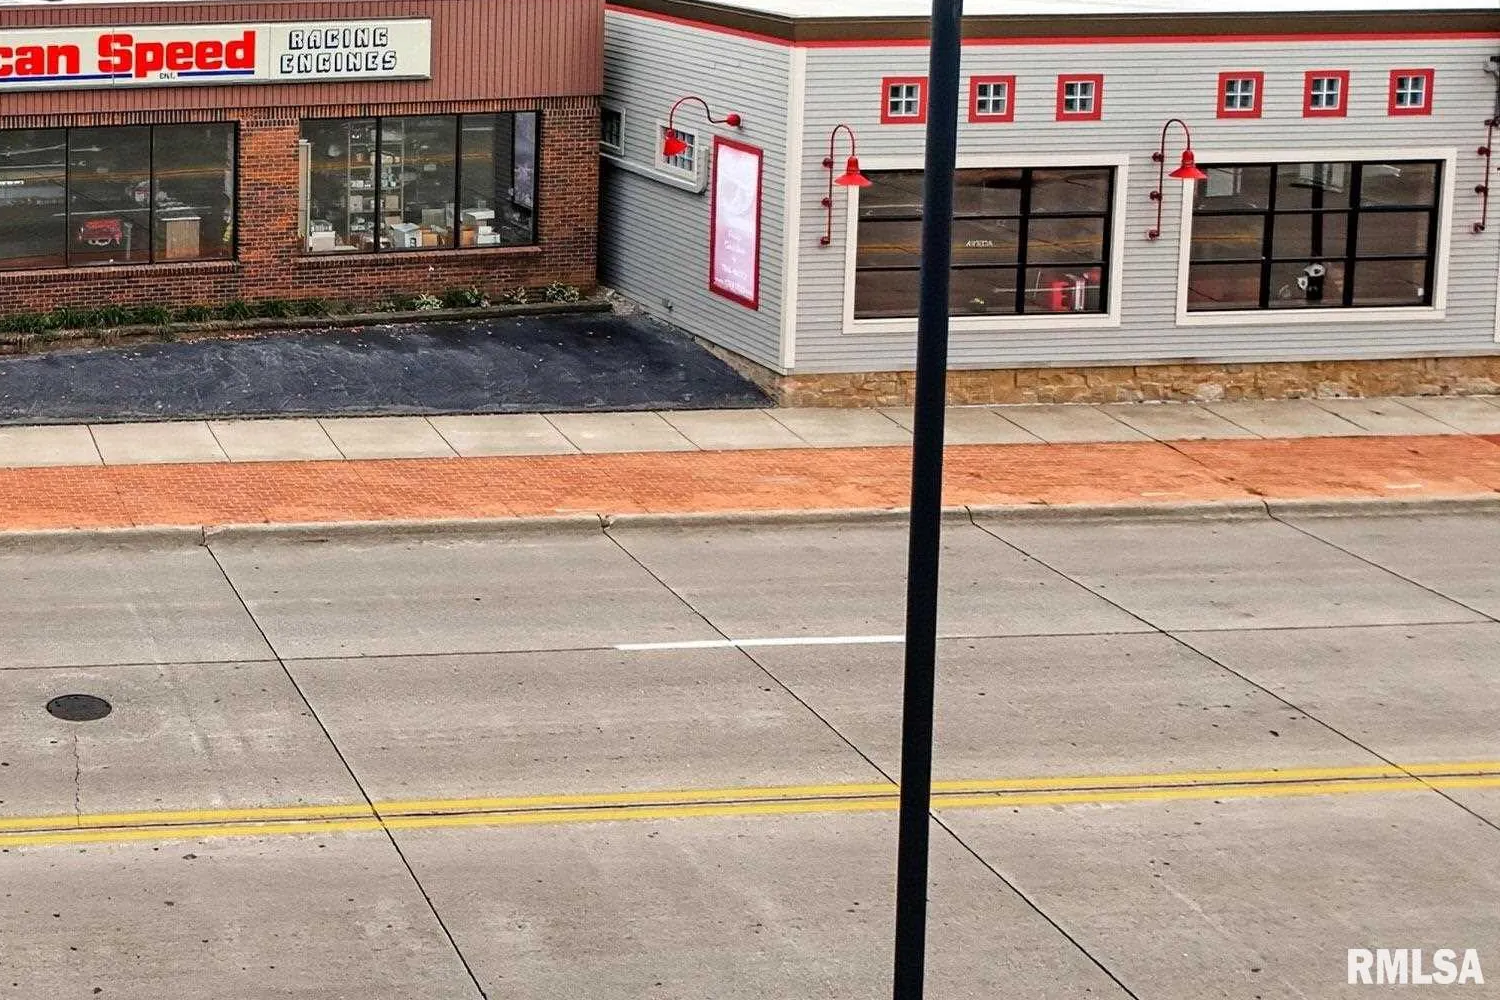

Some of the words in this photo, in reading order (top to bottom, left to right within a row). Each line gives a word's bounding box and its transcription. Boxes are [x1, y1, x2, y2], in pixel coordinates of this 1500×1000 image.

[289, 27, 388, 50] RACING
[98, 31, 255, 77] Speed
[280, 50, 397, 73] ENGINES
